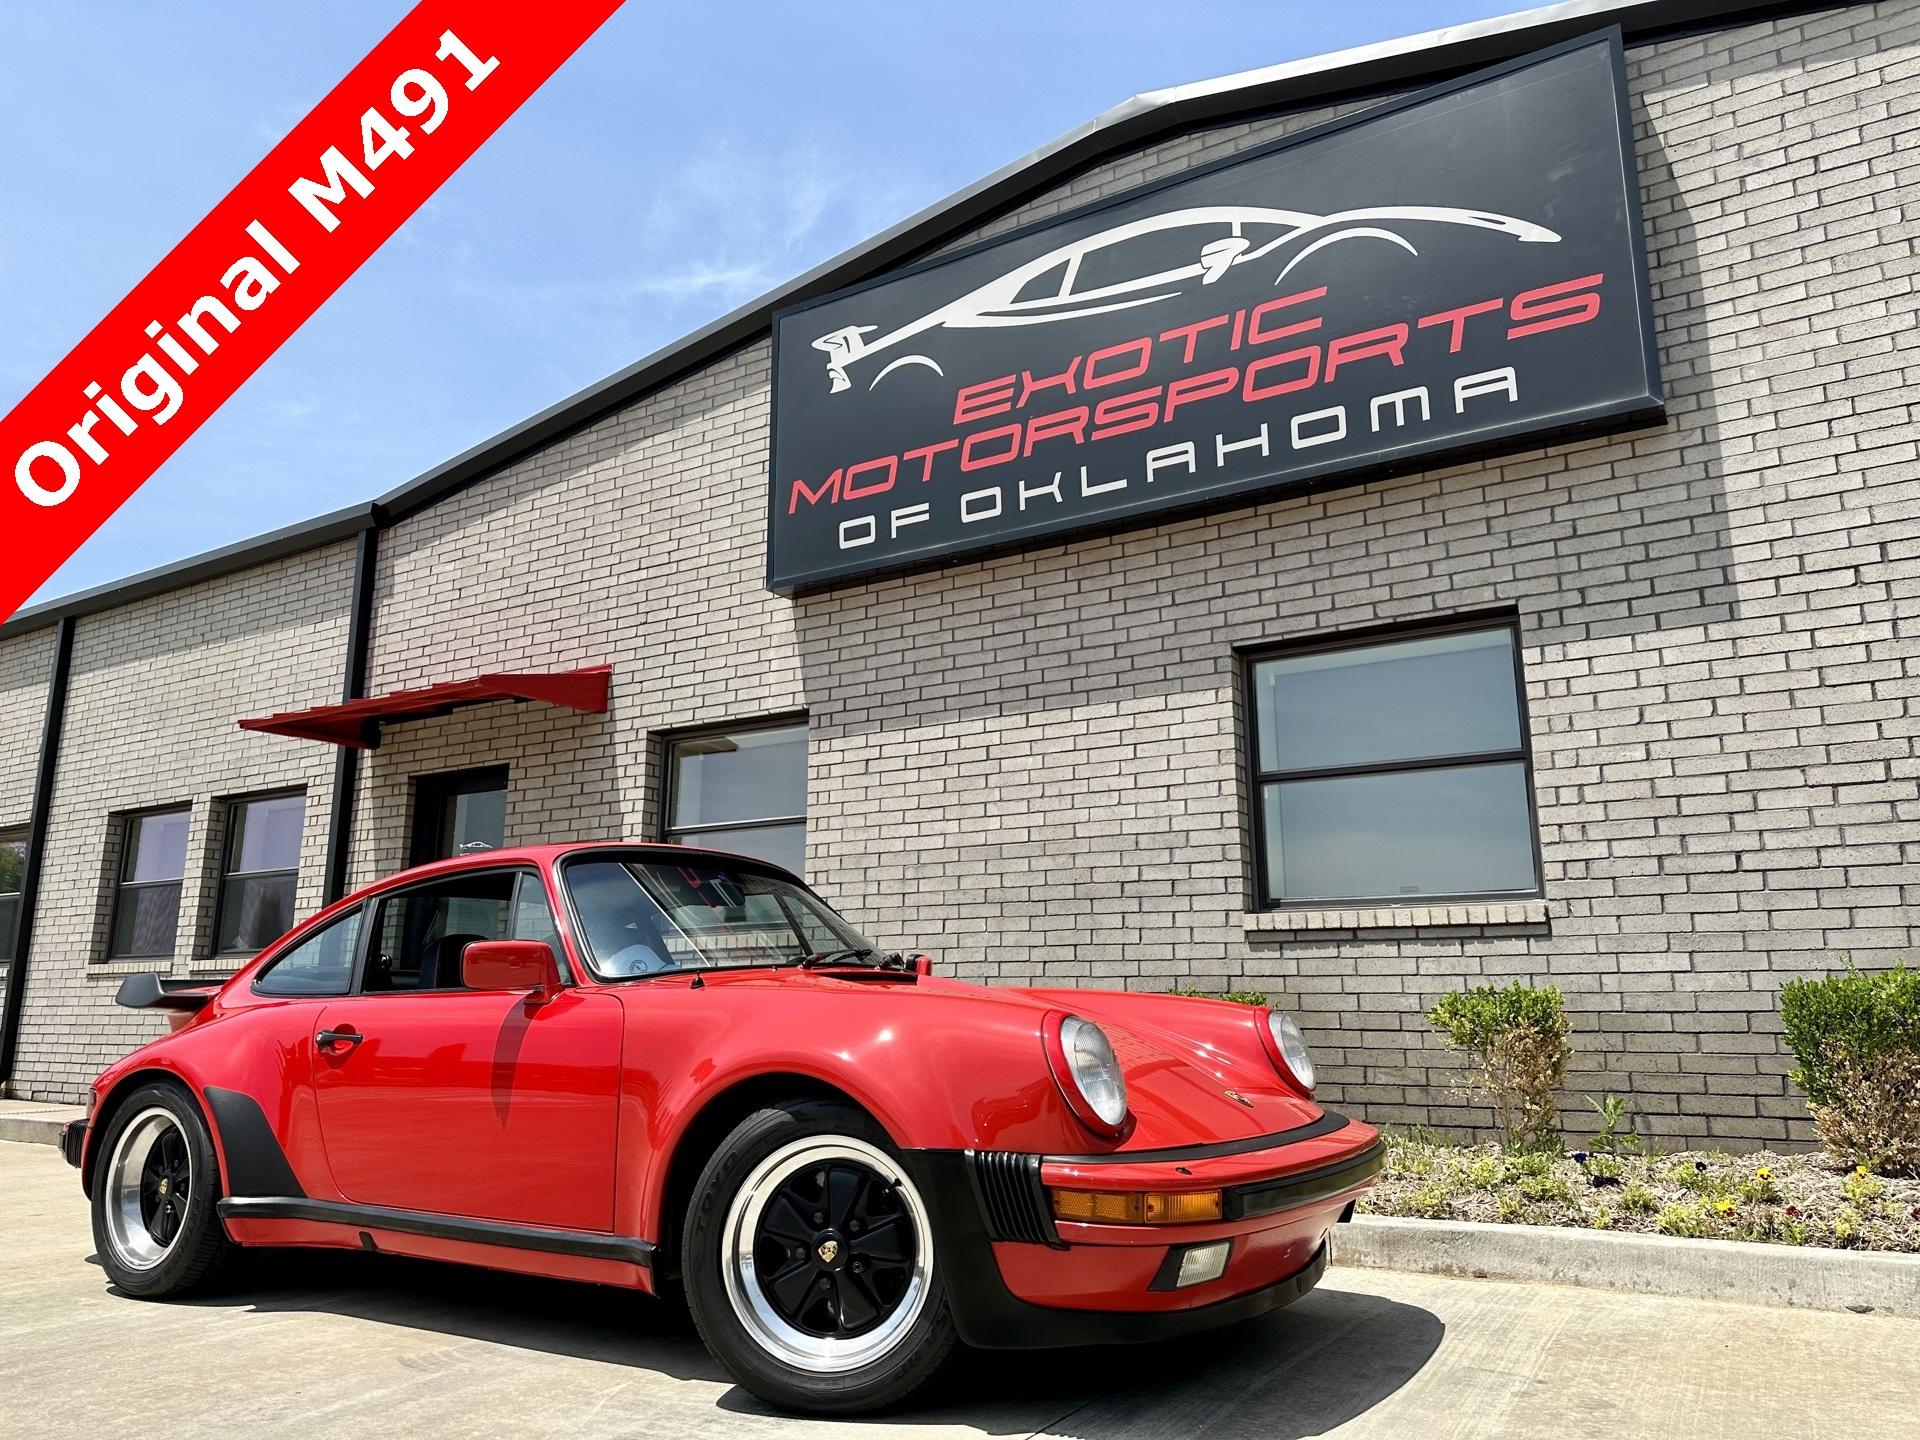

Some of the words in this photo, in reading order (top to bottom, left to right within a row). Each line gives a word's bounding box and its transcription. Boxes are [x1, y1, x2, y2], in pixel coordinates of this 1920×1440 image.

[789, 274, 1603, 514] MOTORSPORTS
[954, 287, 1325, 424] EXOTIC
[839, 503, 931, 549] OF
[961, 367, 1517, 523] OKLAHOMA
